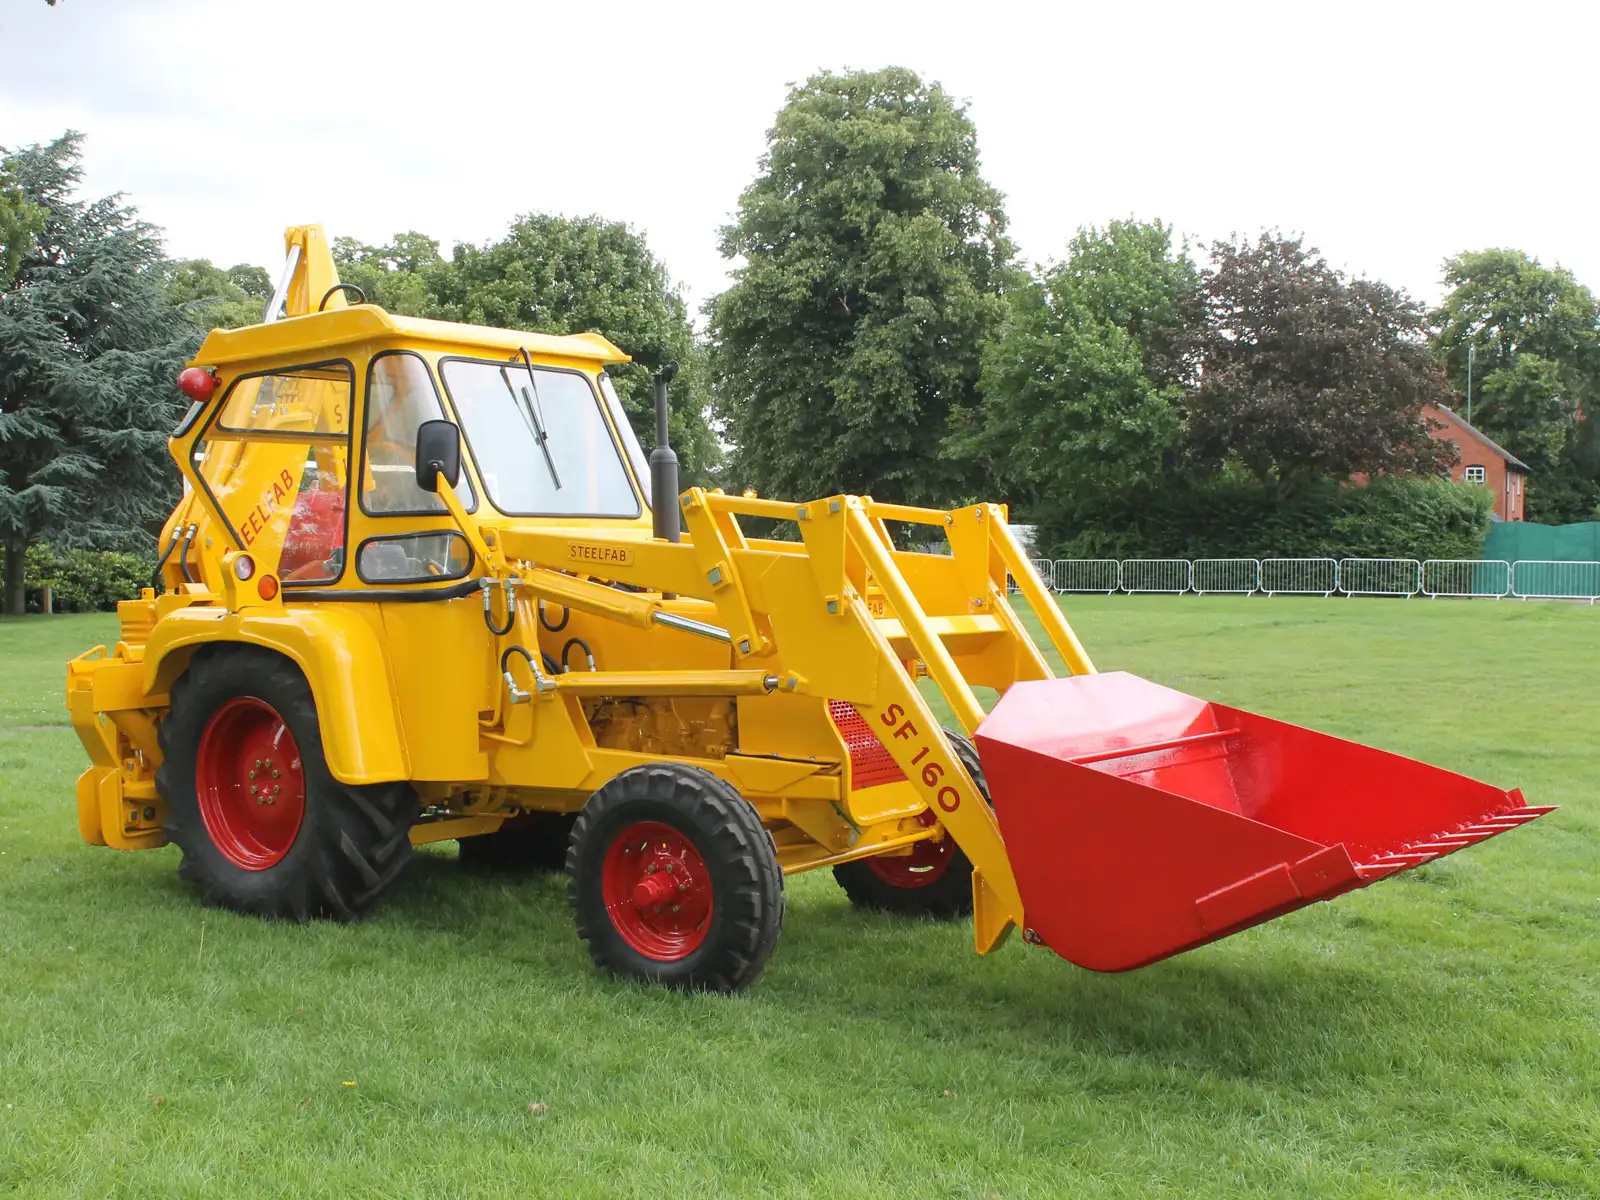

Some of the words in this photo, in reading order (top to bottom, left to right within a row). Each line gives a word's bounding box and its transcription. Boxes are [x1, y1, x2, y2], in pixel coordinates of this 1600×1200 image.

[225, 469, 293, 554] EELFAB
[570, 545, 626, 562] STEELFAB
[880, 703, 918, 740] SF
[911, 746, 960, 813] 160
